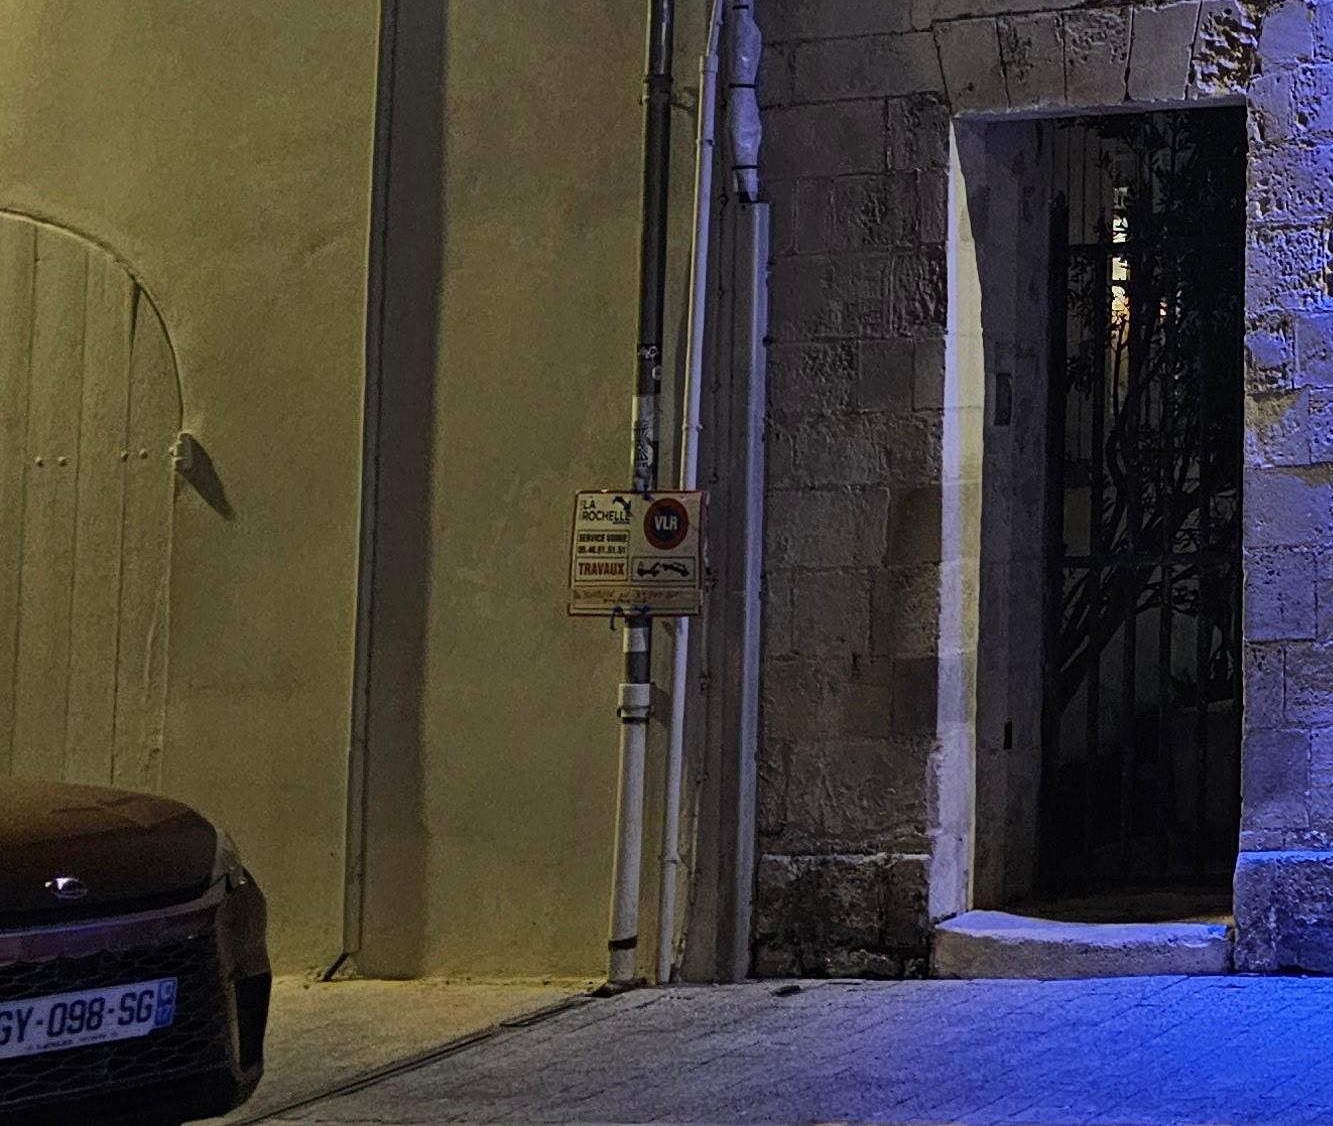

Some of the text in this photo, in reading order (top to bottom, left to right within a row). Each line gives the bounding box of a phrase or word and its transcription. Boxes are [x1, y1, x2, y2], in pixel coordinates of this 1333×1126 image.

[582, 500, 596, 510] LA
[654, 515, 678, 531] VLR
[578, 562, 625, 576] TRAVAUX
